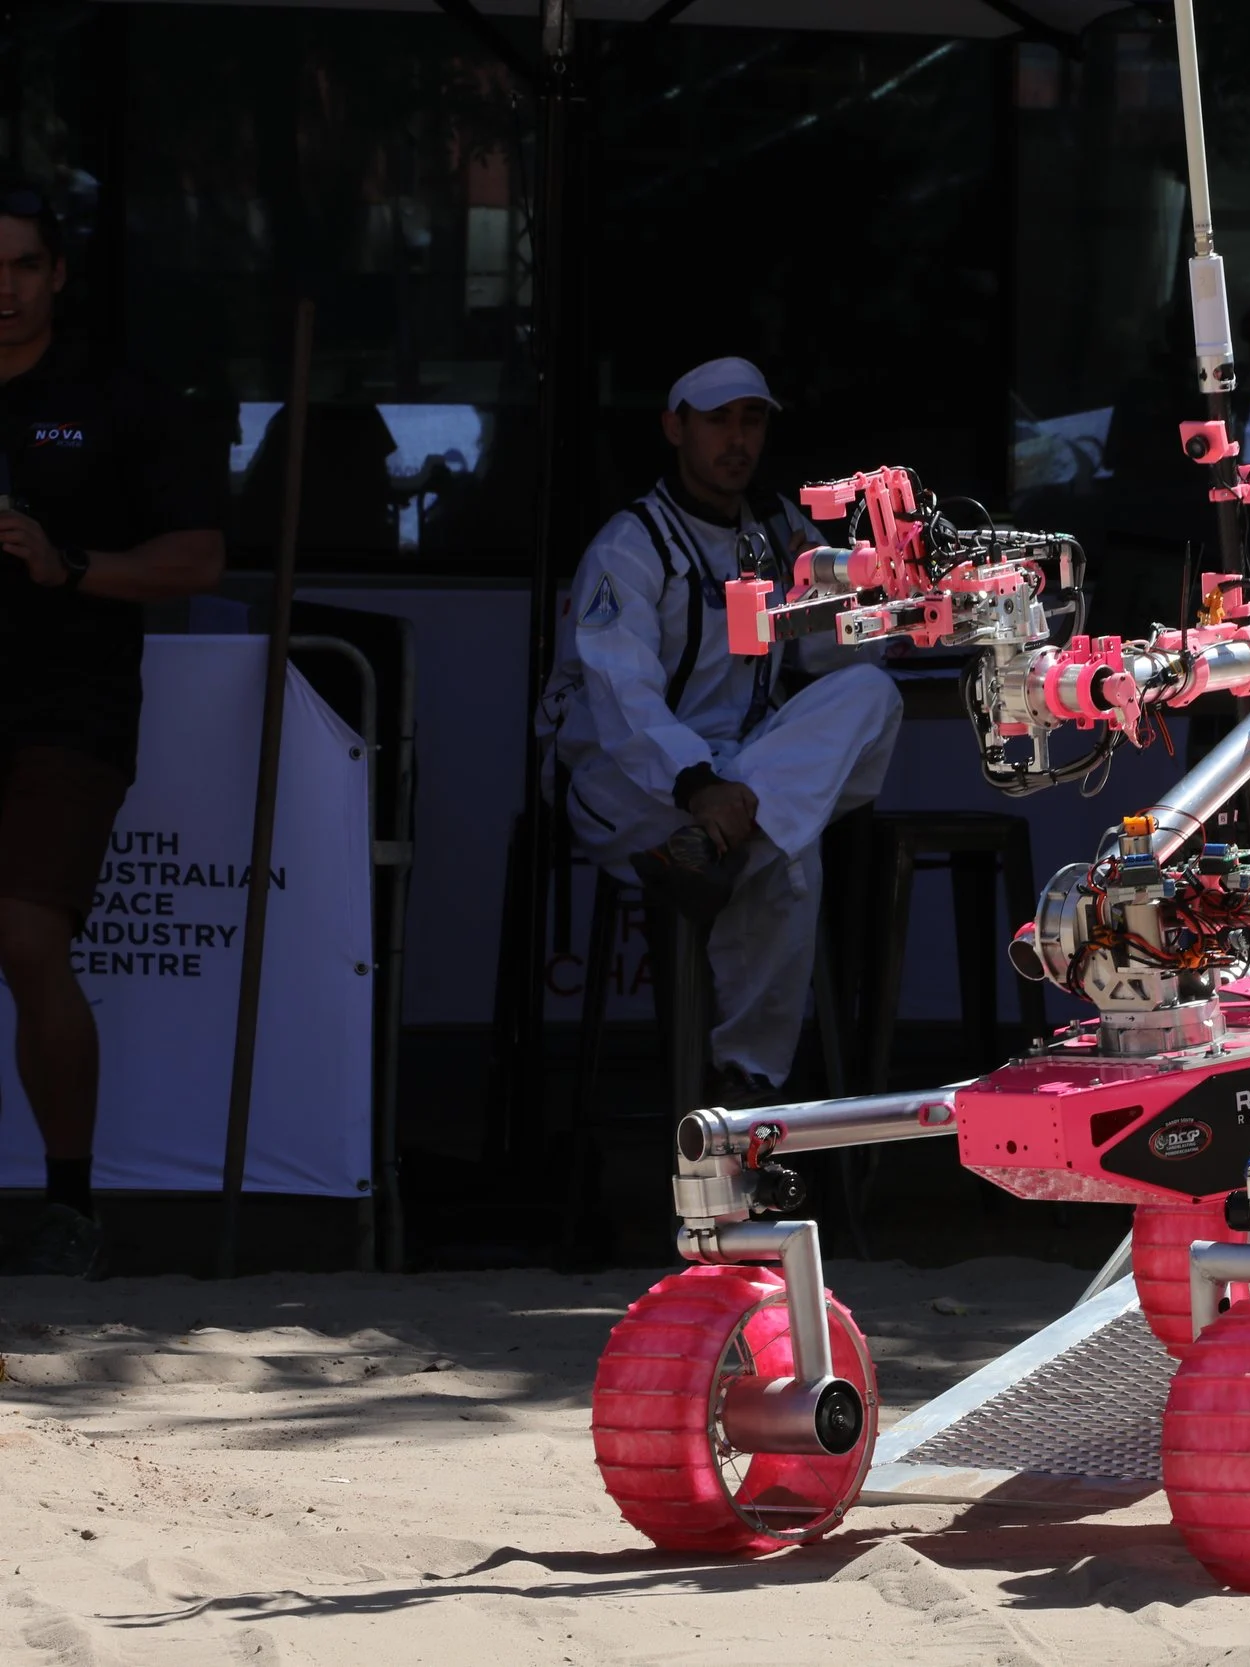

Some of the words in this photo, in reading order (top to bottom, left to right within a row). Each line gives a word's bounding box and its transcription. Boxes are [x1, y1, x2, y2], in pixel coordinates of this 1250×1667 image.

[35, 429, 83, 440] NOVA
[111, 831, 178, 856] UTH
[97, 862, 286, 890] USTRALIAN
[92, 892, 174, 916] PACE
[76, 922, 238, 948] NDUSTRY
[69, 951, 201, 977] CENTRE
